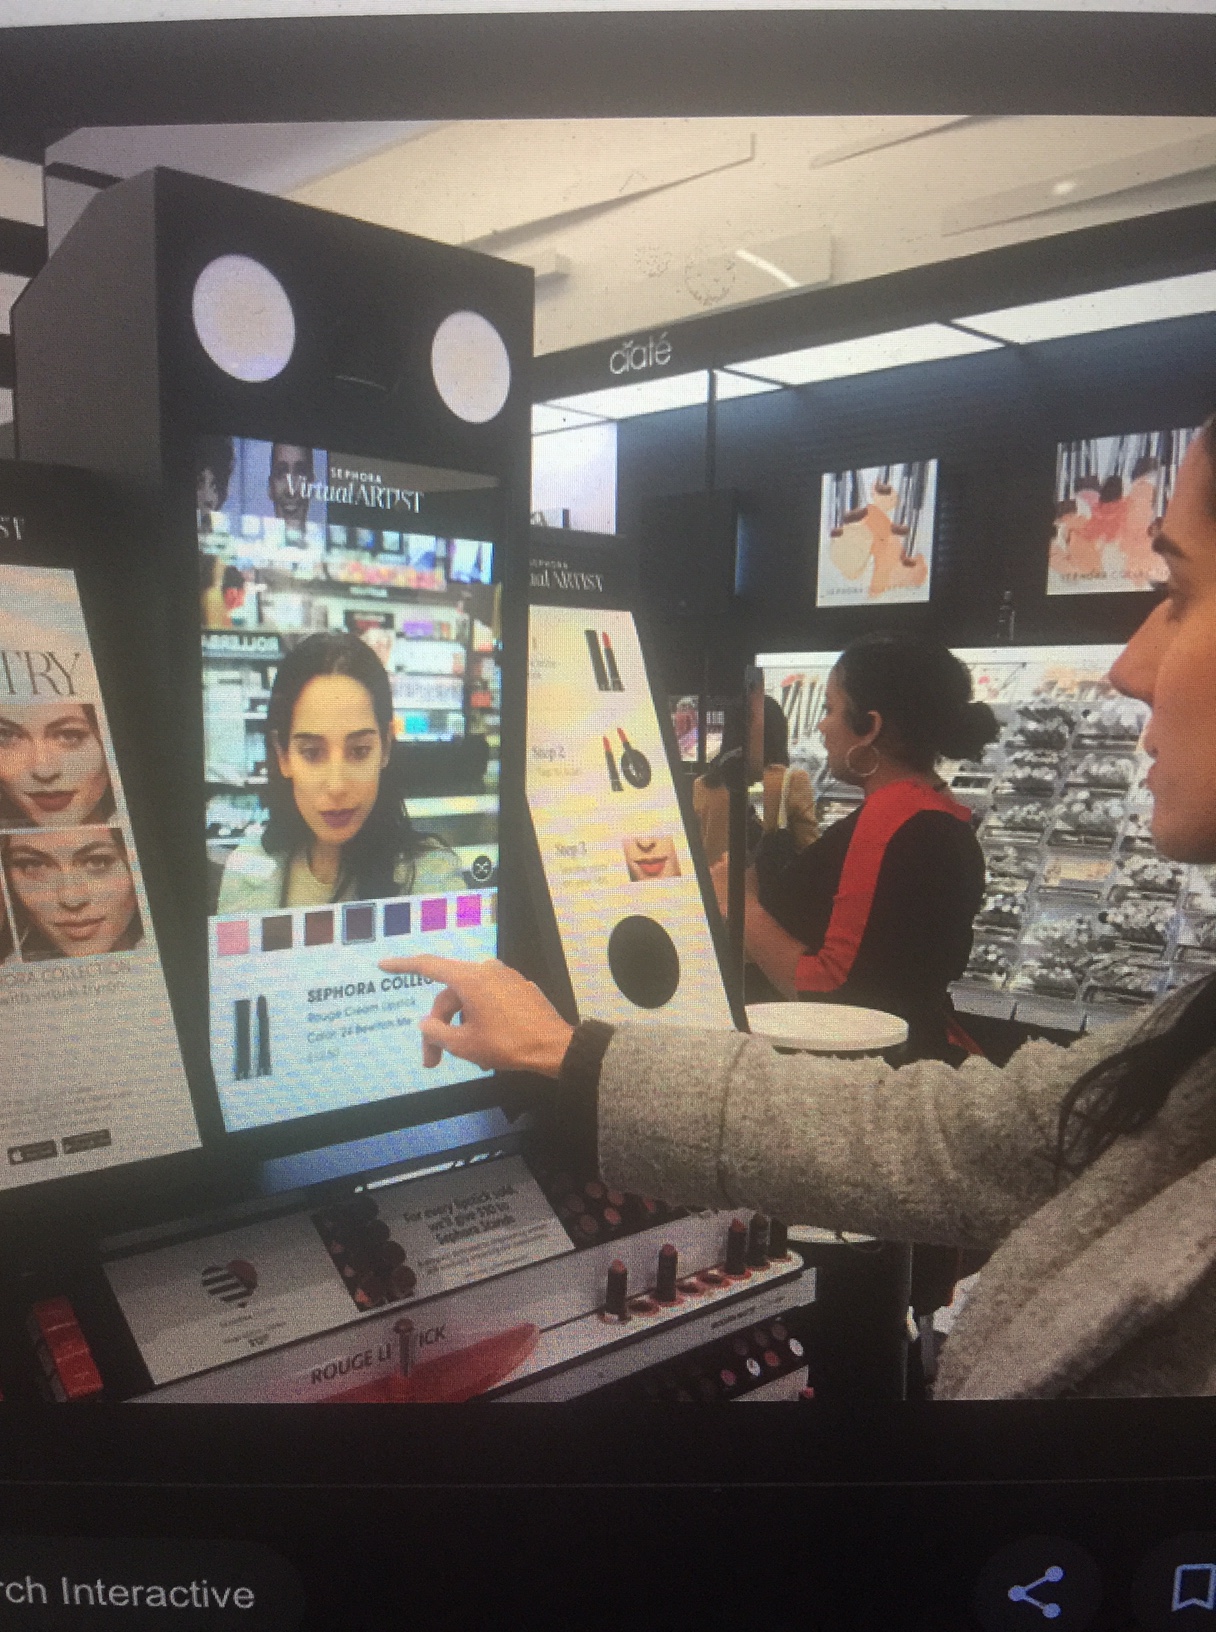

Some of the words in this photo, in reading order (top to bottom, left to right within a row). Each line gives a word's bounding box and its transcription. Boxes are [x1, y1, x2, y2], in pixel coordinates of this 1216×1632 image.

[330, 466, 382, 485] SEPHORA
[307, 981, 377, 1003] SEPHORA
[310, 1349, 373, 1385] ROUGE
[0, 1575, 48, 1605] ch
[61, 1576, 255, 1609] Interactive
